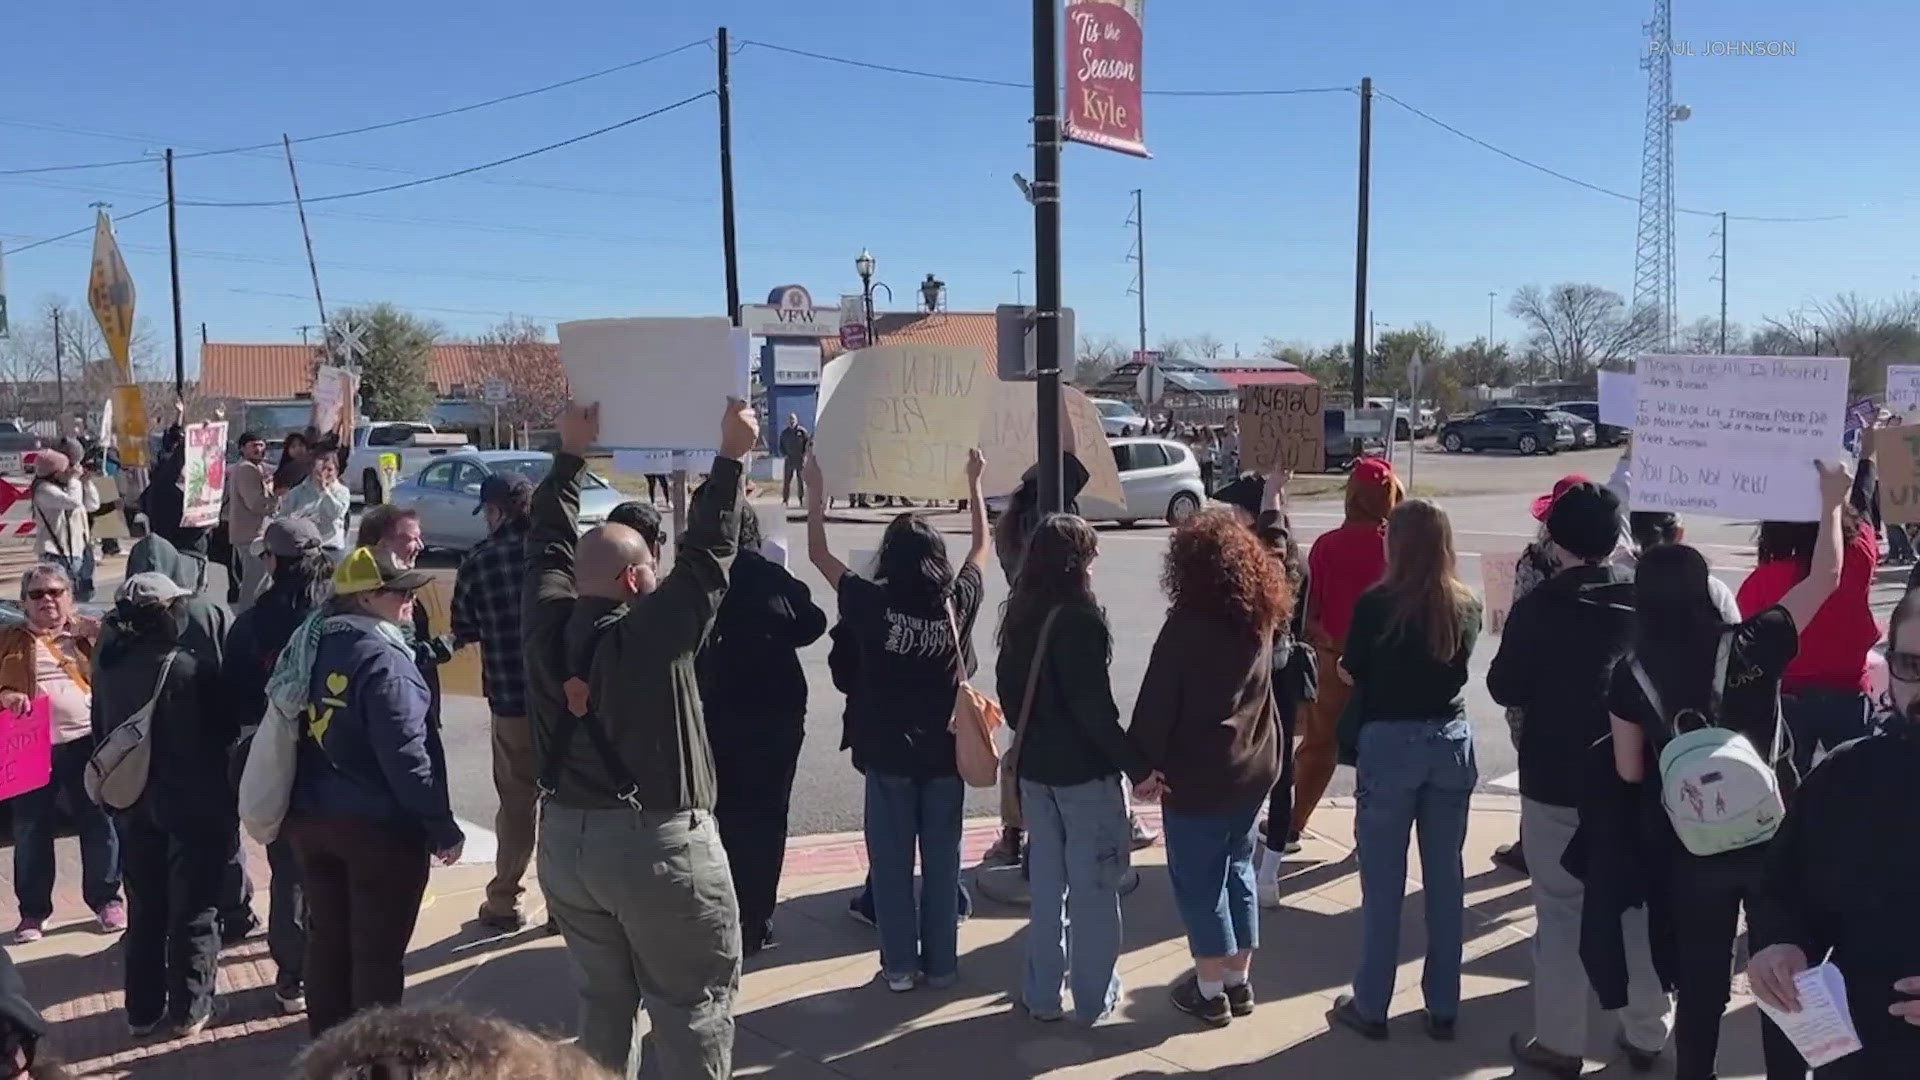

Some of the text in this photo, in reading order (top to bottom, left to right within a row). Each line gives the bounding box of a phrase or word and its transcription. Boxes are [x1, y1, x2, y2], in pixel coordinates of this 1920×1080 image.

[1104, 22, 1120, 41] the
[1077, 47, 1136, 82] Season
[1081, 86, 1127, 130] Kyle
[775, 309, 817, 323] VFW
[1669, 464, 1690, 485] Do
